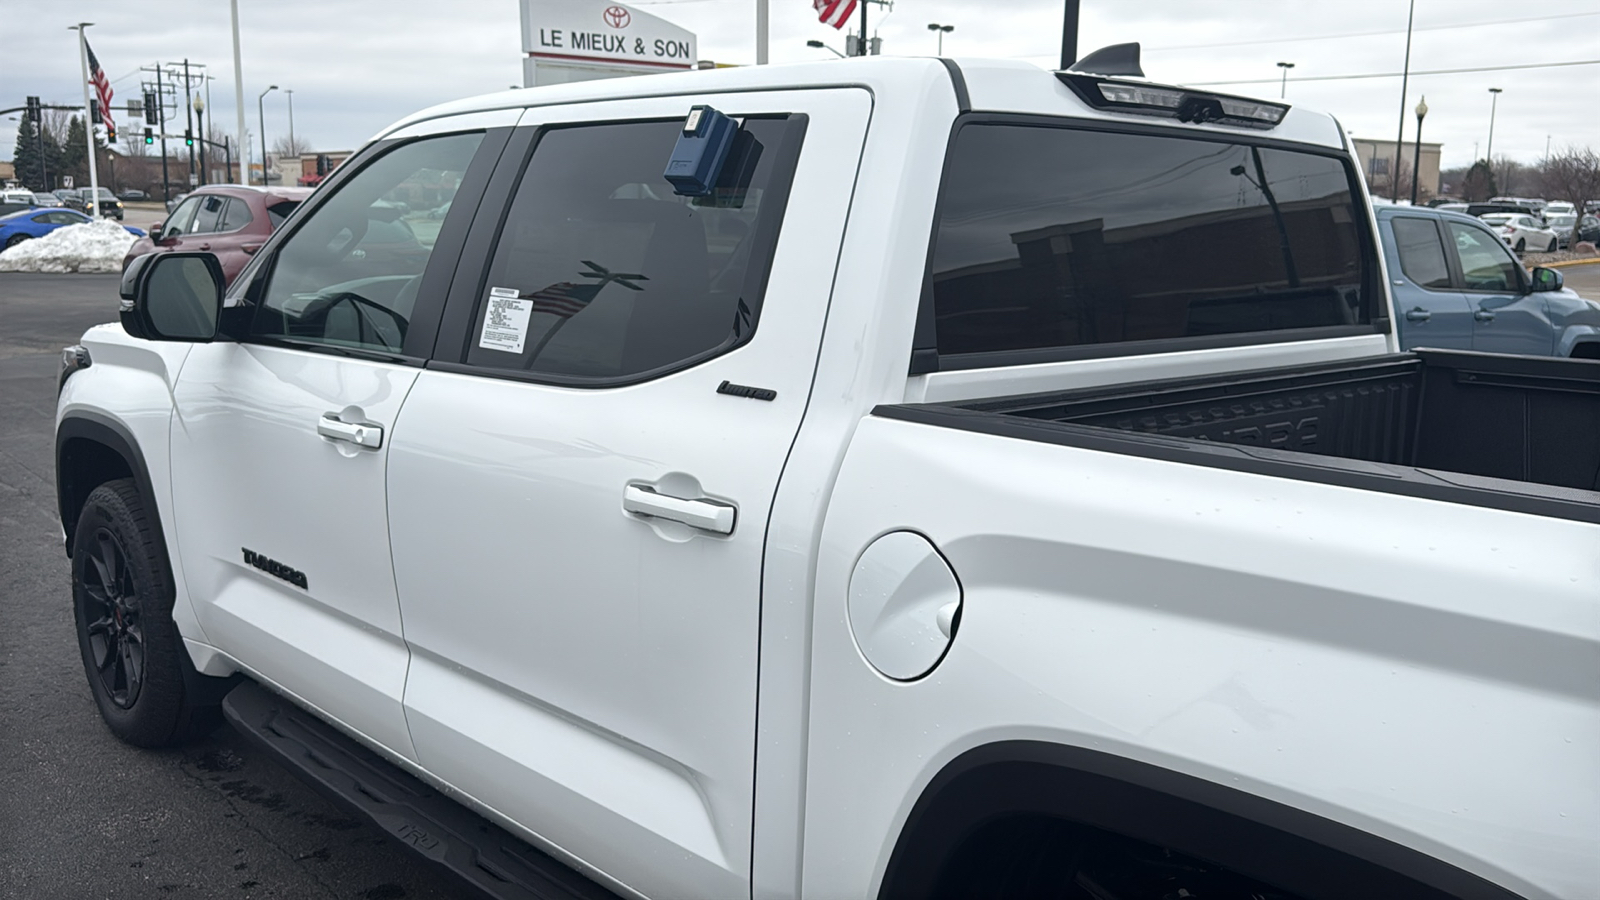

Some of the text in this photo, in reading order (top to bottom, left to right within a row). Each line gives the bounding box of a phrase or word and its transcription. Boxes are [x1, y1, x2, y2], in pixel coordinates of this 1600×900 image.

[540, 28, 690, 59] LE MIEUX & SON
[241, 546, 308, 590] TUNDRA
